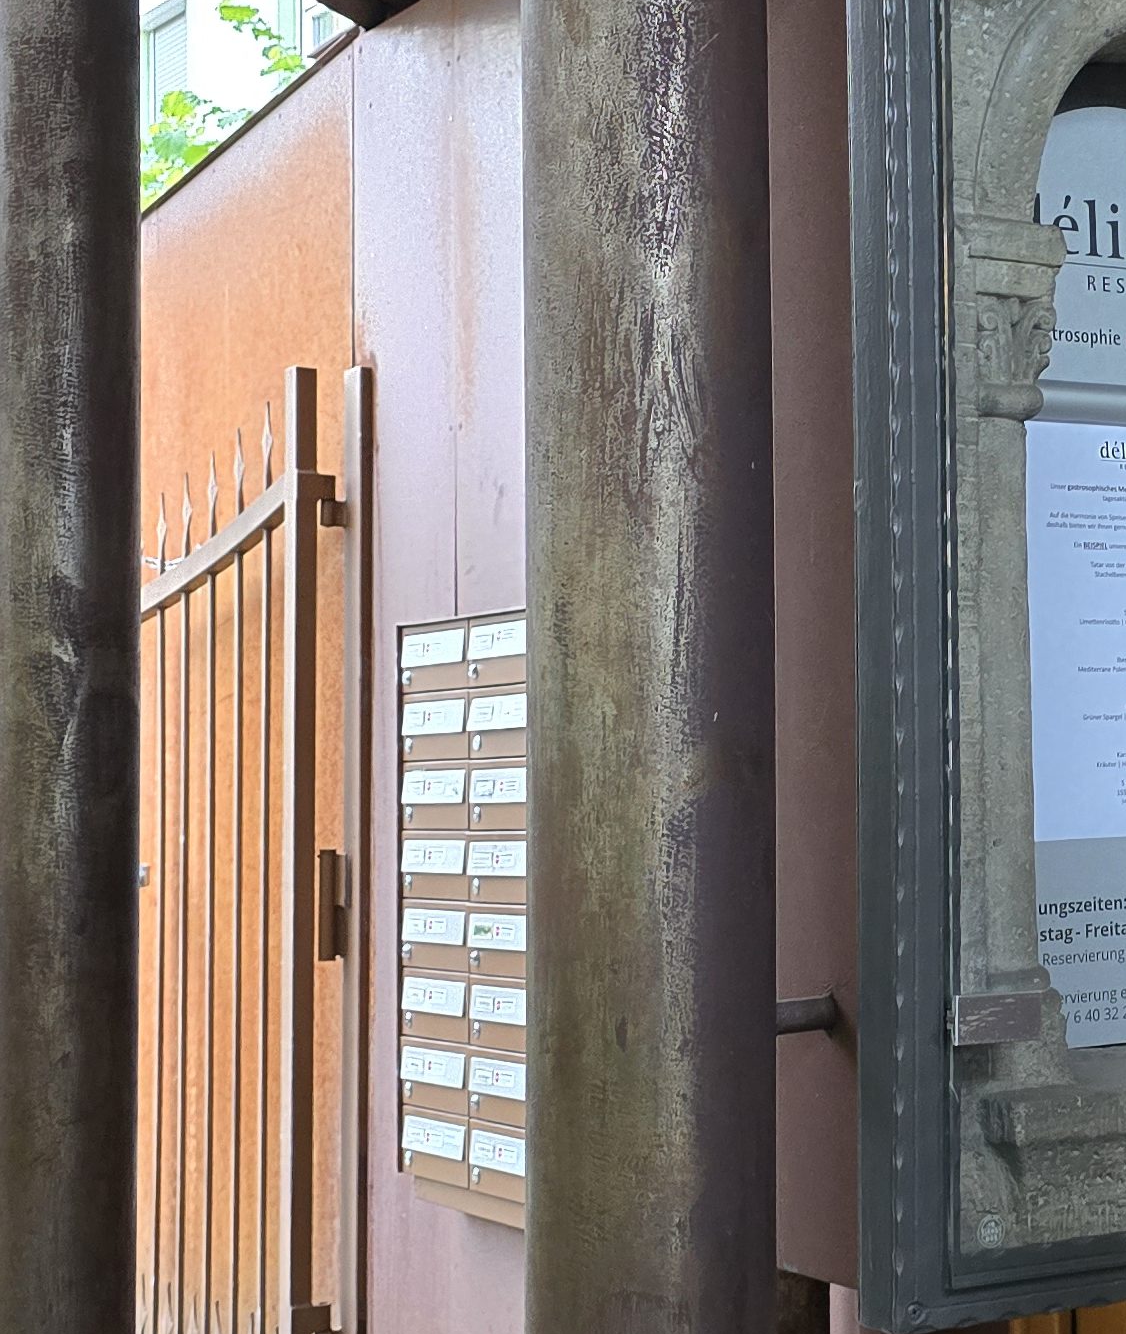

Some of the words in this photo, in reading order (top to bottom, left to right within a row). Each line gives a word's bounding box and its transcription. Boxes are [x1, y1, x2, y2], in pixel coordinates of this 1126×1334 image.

[1039, 926, 1074, 944] stag
[1042, 948, 1125, 967] Reservierung
[1073, 1010, 1082, 1024] 6
[1084, 1008, 1100, 1022] 40
[1103, 1007, 1119, 1021] 32
